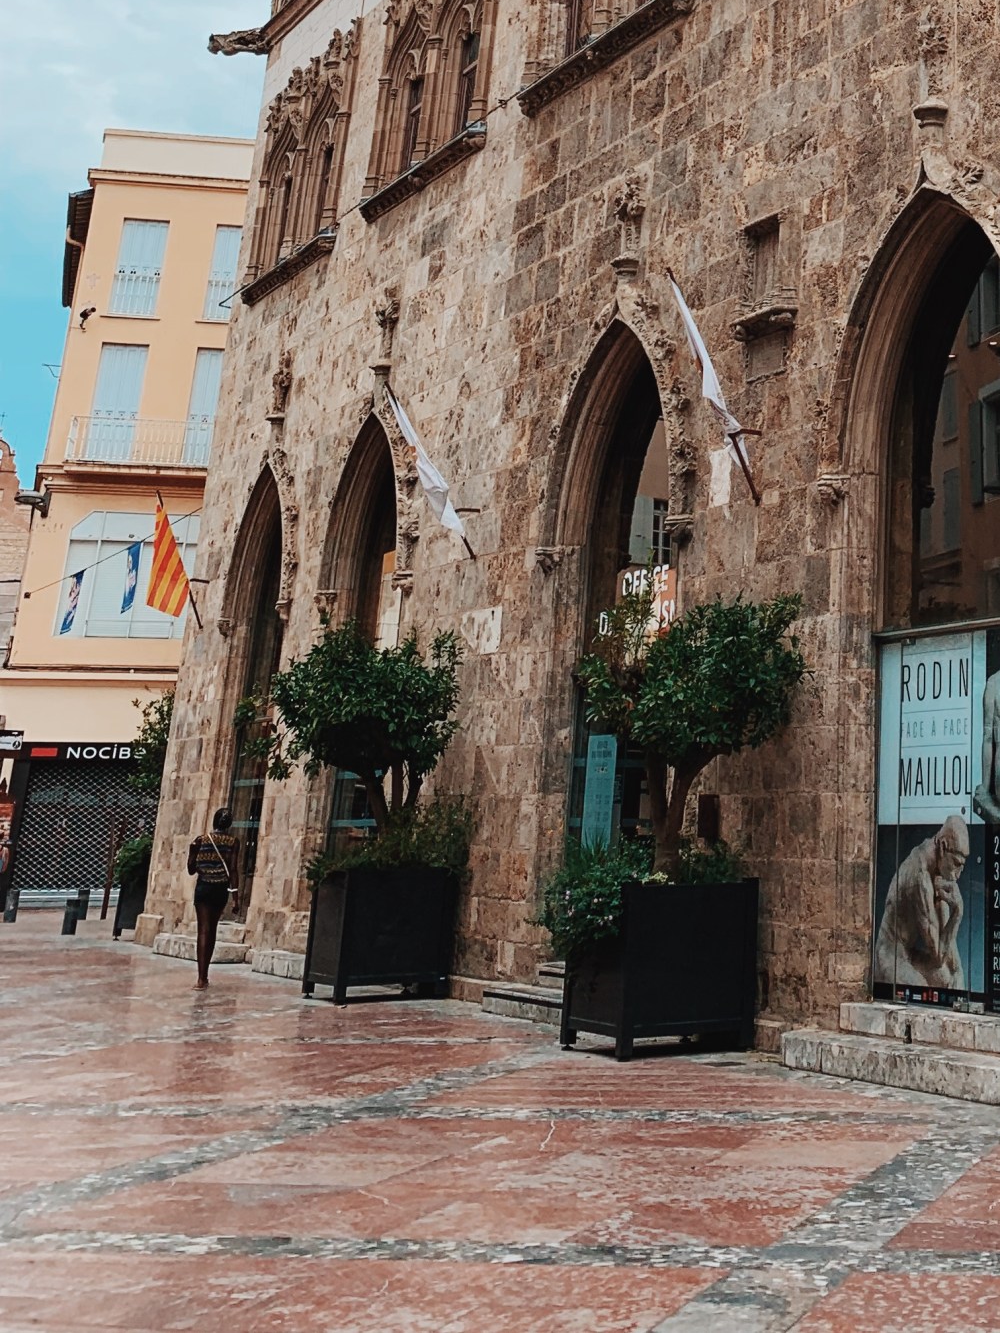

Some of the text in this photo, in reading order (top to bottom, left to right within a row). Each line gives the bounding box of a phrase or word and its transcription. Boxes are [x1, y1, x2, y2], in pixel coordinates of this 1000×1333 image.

[622, 563, 669, 596] OFFCE
[901, 658, 969, 703] RODIN
[943, 717, 968, 737] FACE
[899, 755, 972, 797] MAILLOL
[994, 861, 1000, 881] 3
